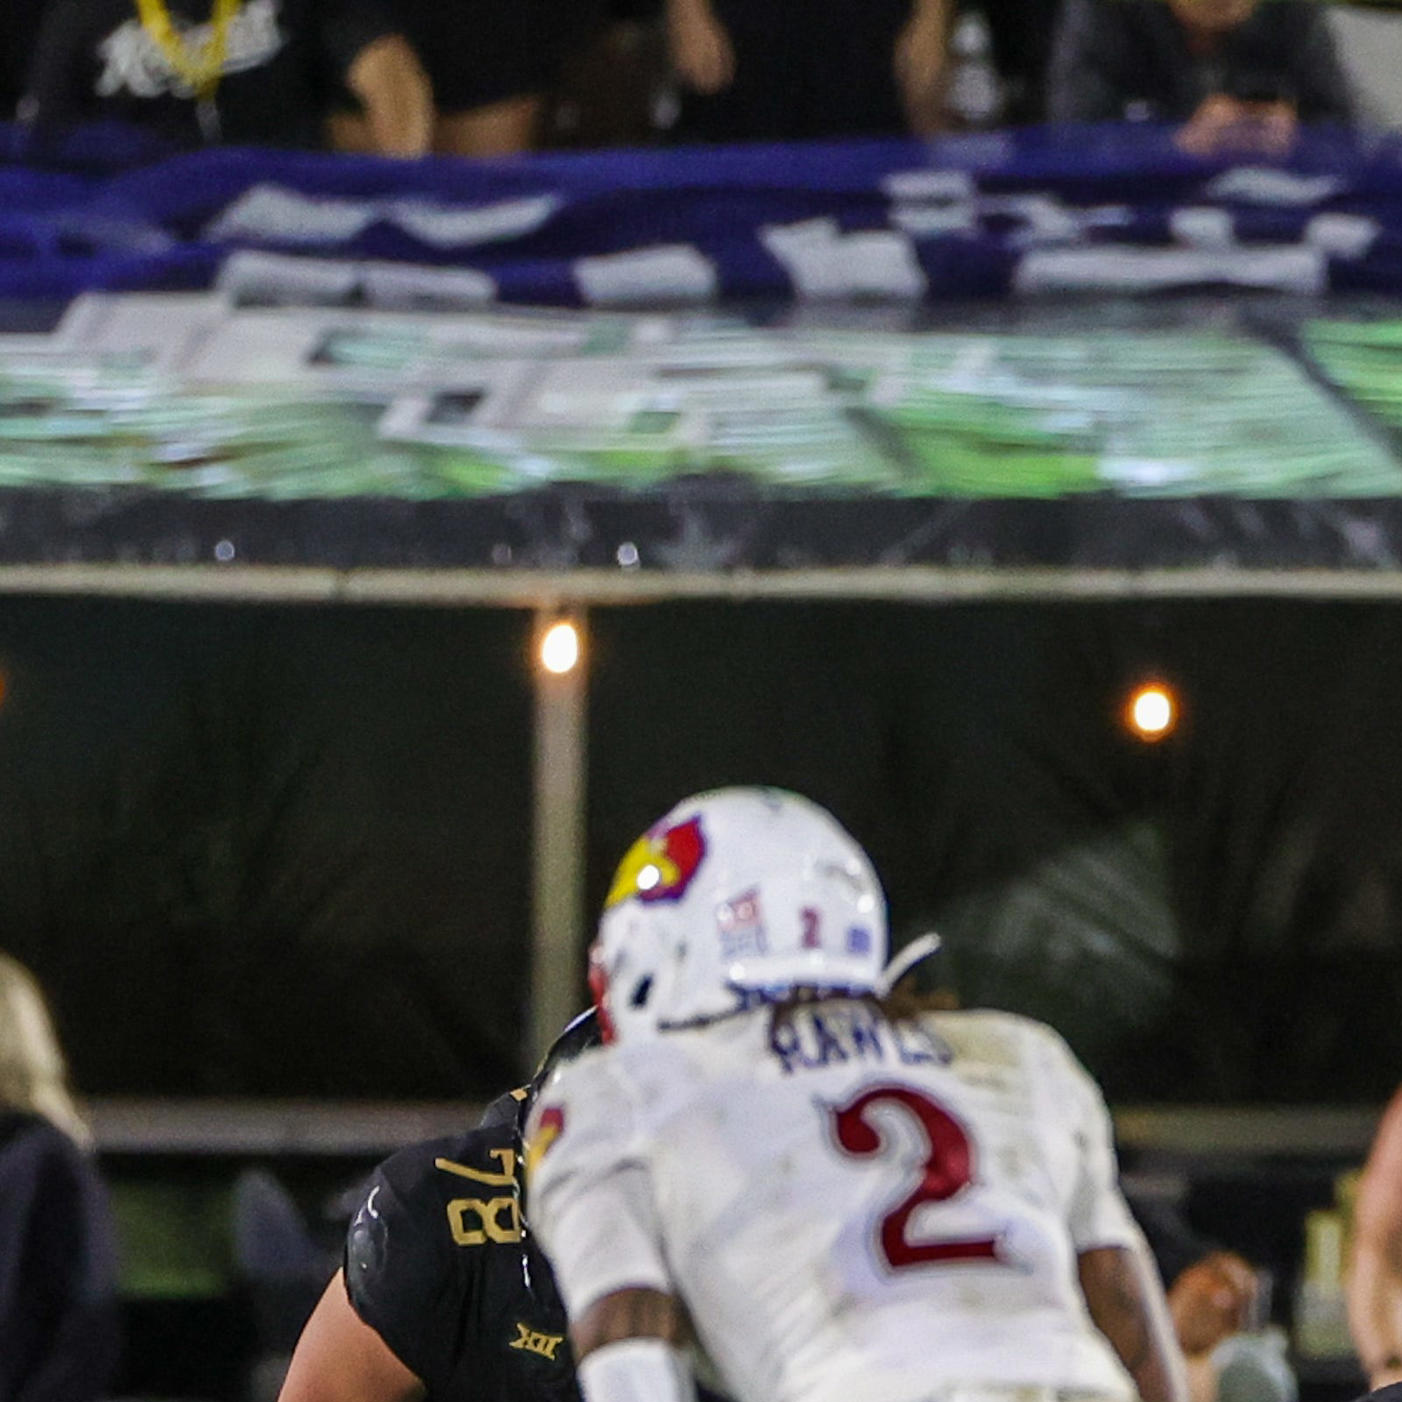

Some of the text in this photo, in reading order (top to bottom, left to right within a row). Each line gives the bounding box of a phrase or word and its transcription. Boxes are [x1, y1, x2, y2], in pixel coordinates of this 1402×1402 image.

[434, 1148, 522, 1246] 78
[818, 1076, 1030, 1276] 2
[509, 1321, 563, 1360] XII
